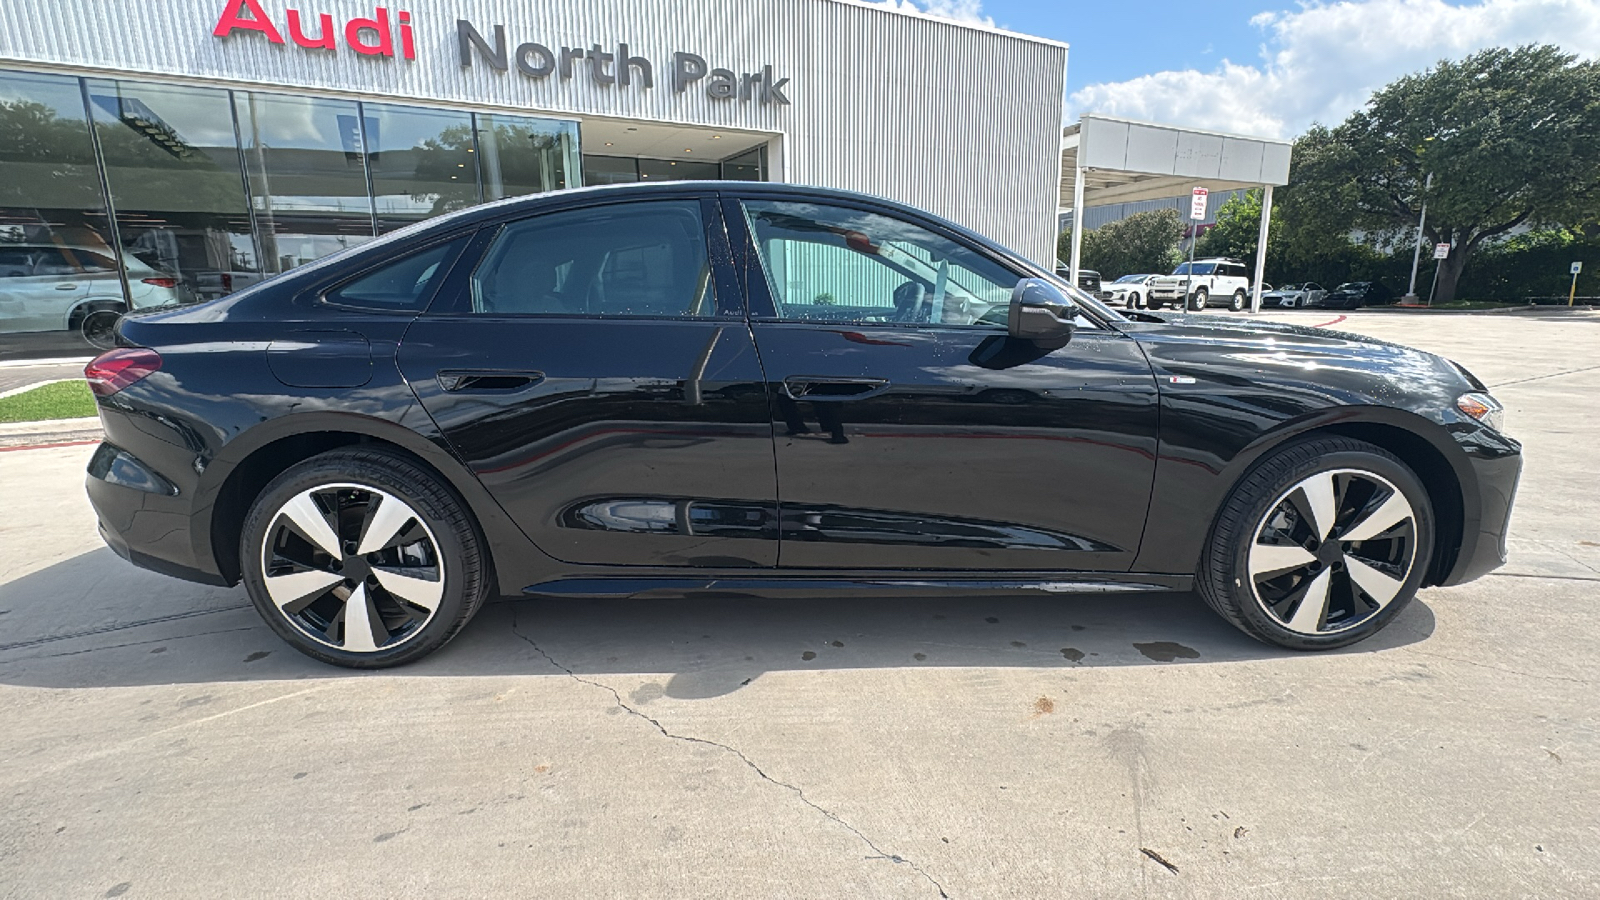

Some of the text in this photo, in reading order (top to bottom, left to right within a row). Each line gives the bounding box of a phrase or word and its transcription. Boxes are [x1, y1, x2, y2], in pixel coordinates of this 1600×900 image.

[213, 0, 791, 105] Audi North Park
